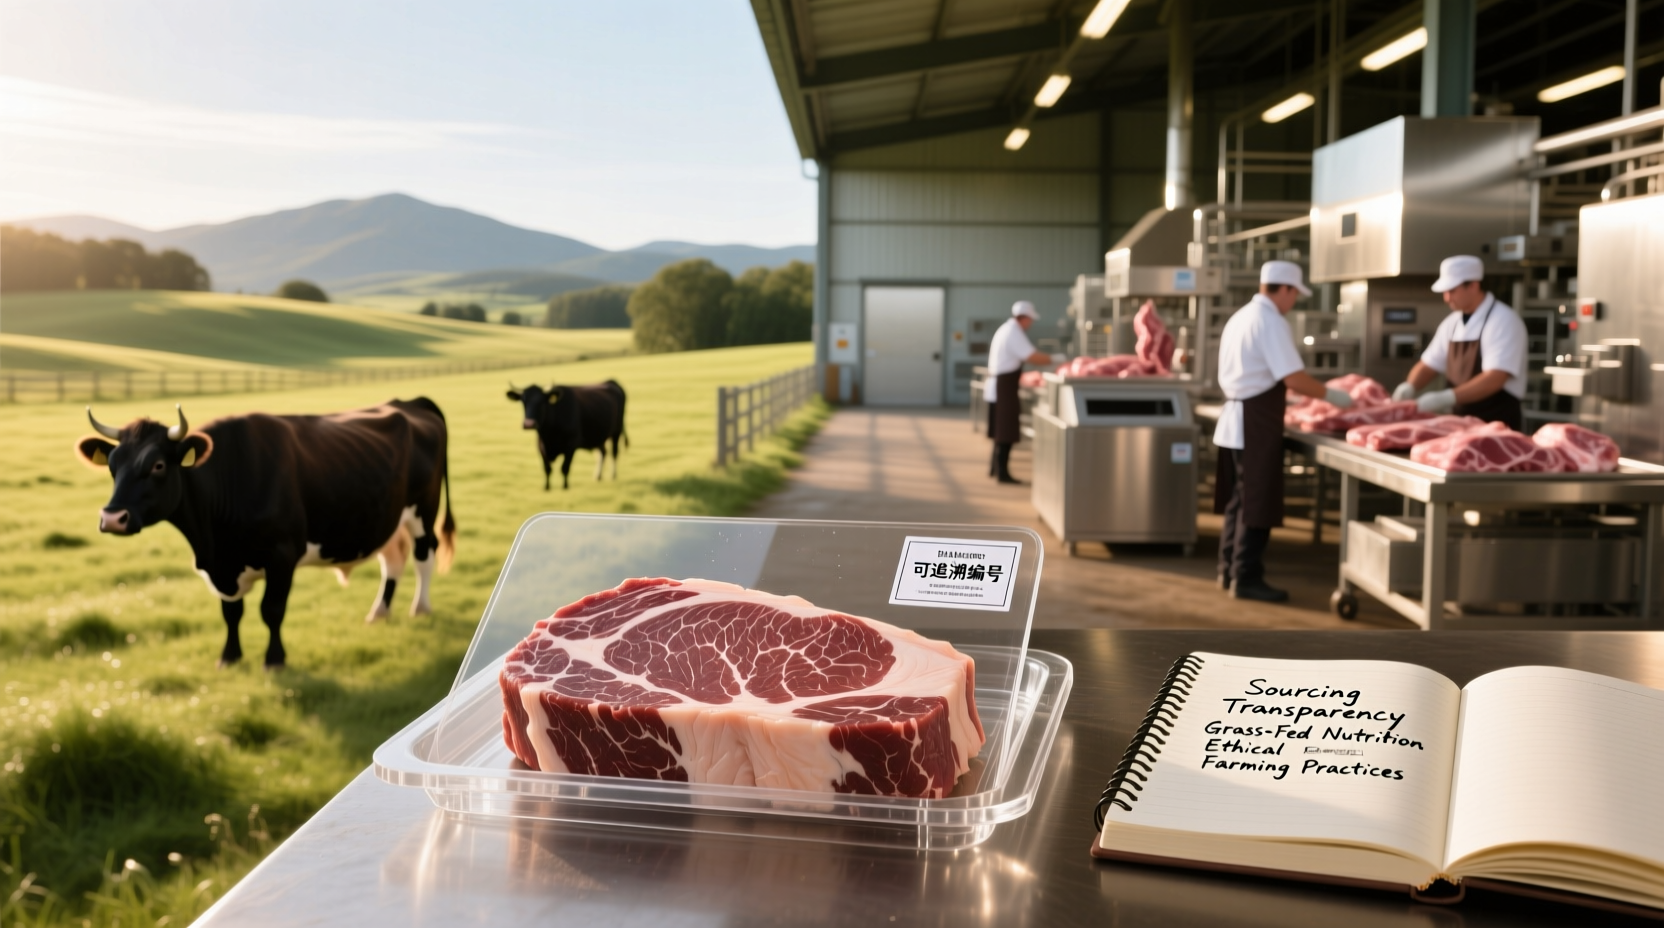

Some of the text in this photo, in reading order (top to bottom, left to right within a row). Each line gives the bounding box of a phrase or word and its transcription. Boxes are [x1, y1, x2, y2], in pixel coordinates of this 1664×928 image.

[1245, 678, 1361, 707] Sourcing
[1223, 698, 1406, 731] Transparency
[1204, 720, 1313, 740] Grass-Fed
[1322, 726, 1424, 751] Nutrition
[1205, 738, 1285, 756] Ethical
[1201, 755, 1405, 781] Farming Practices
